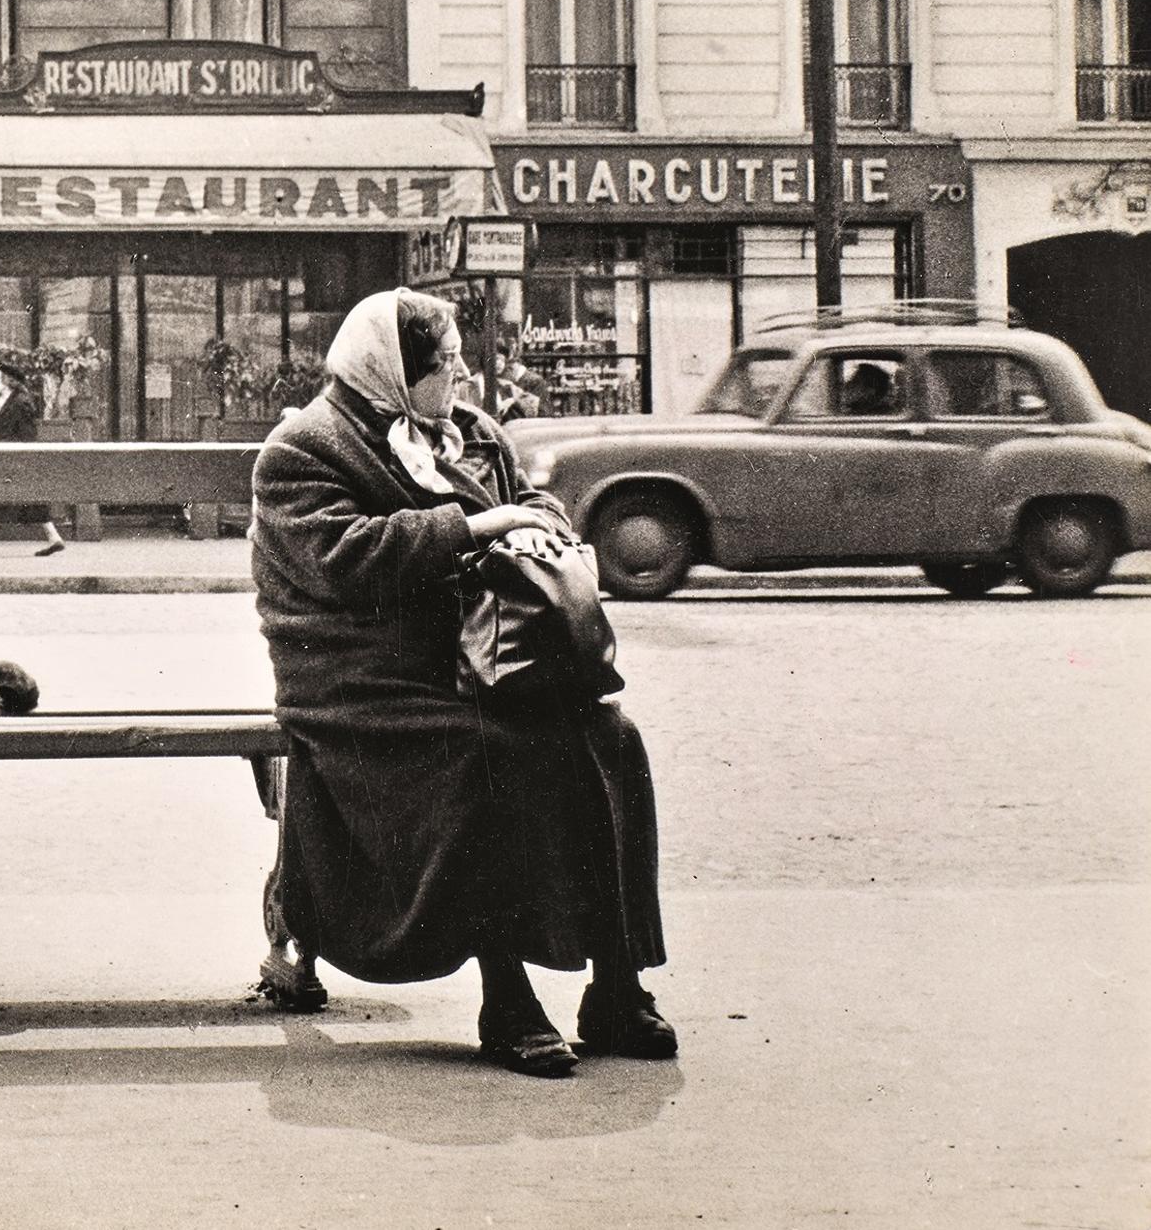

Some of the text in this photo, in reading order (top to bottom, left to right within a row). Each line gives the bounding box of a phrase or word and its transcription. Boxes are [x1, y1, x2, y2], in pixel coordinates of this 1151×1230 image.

[44, 59, 193, 96] RESTAURANT
[513, 158, 889, 205] CHARCUTEIE
[928, 182, 966, 203] 70
